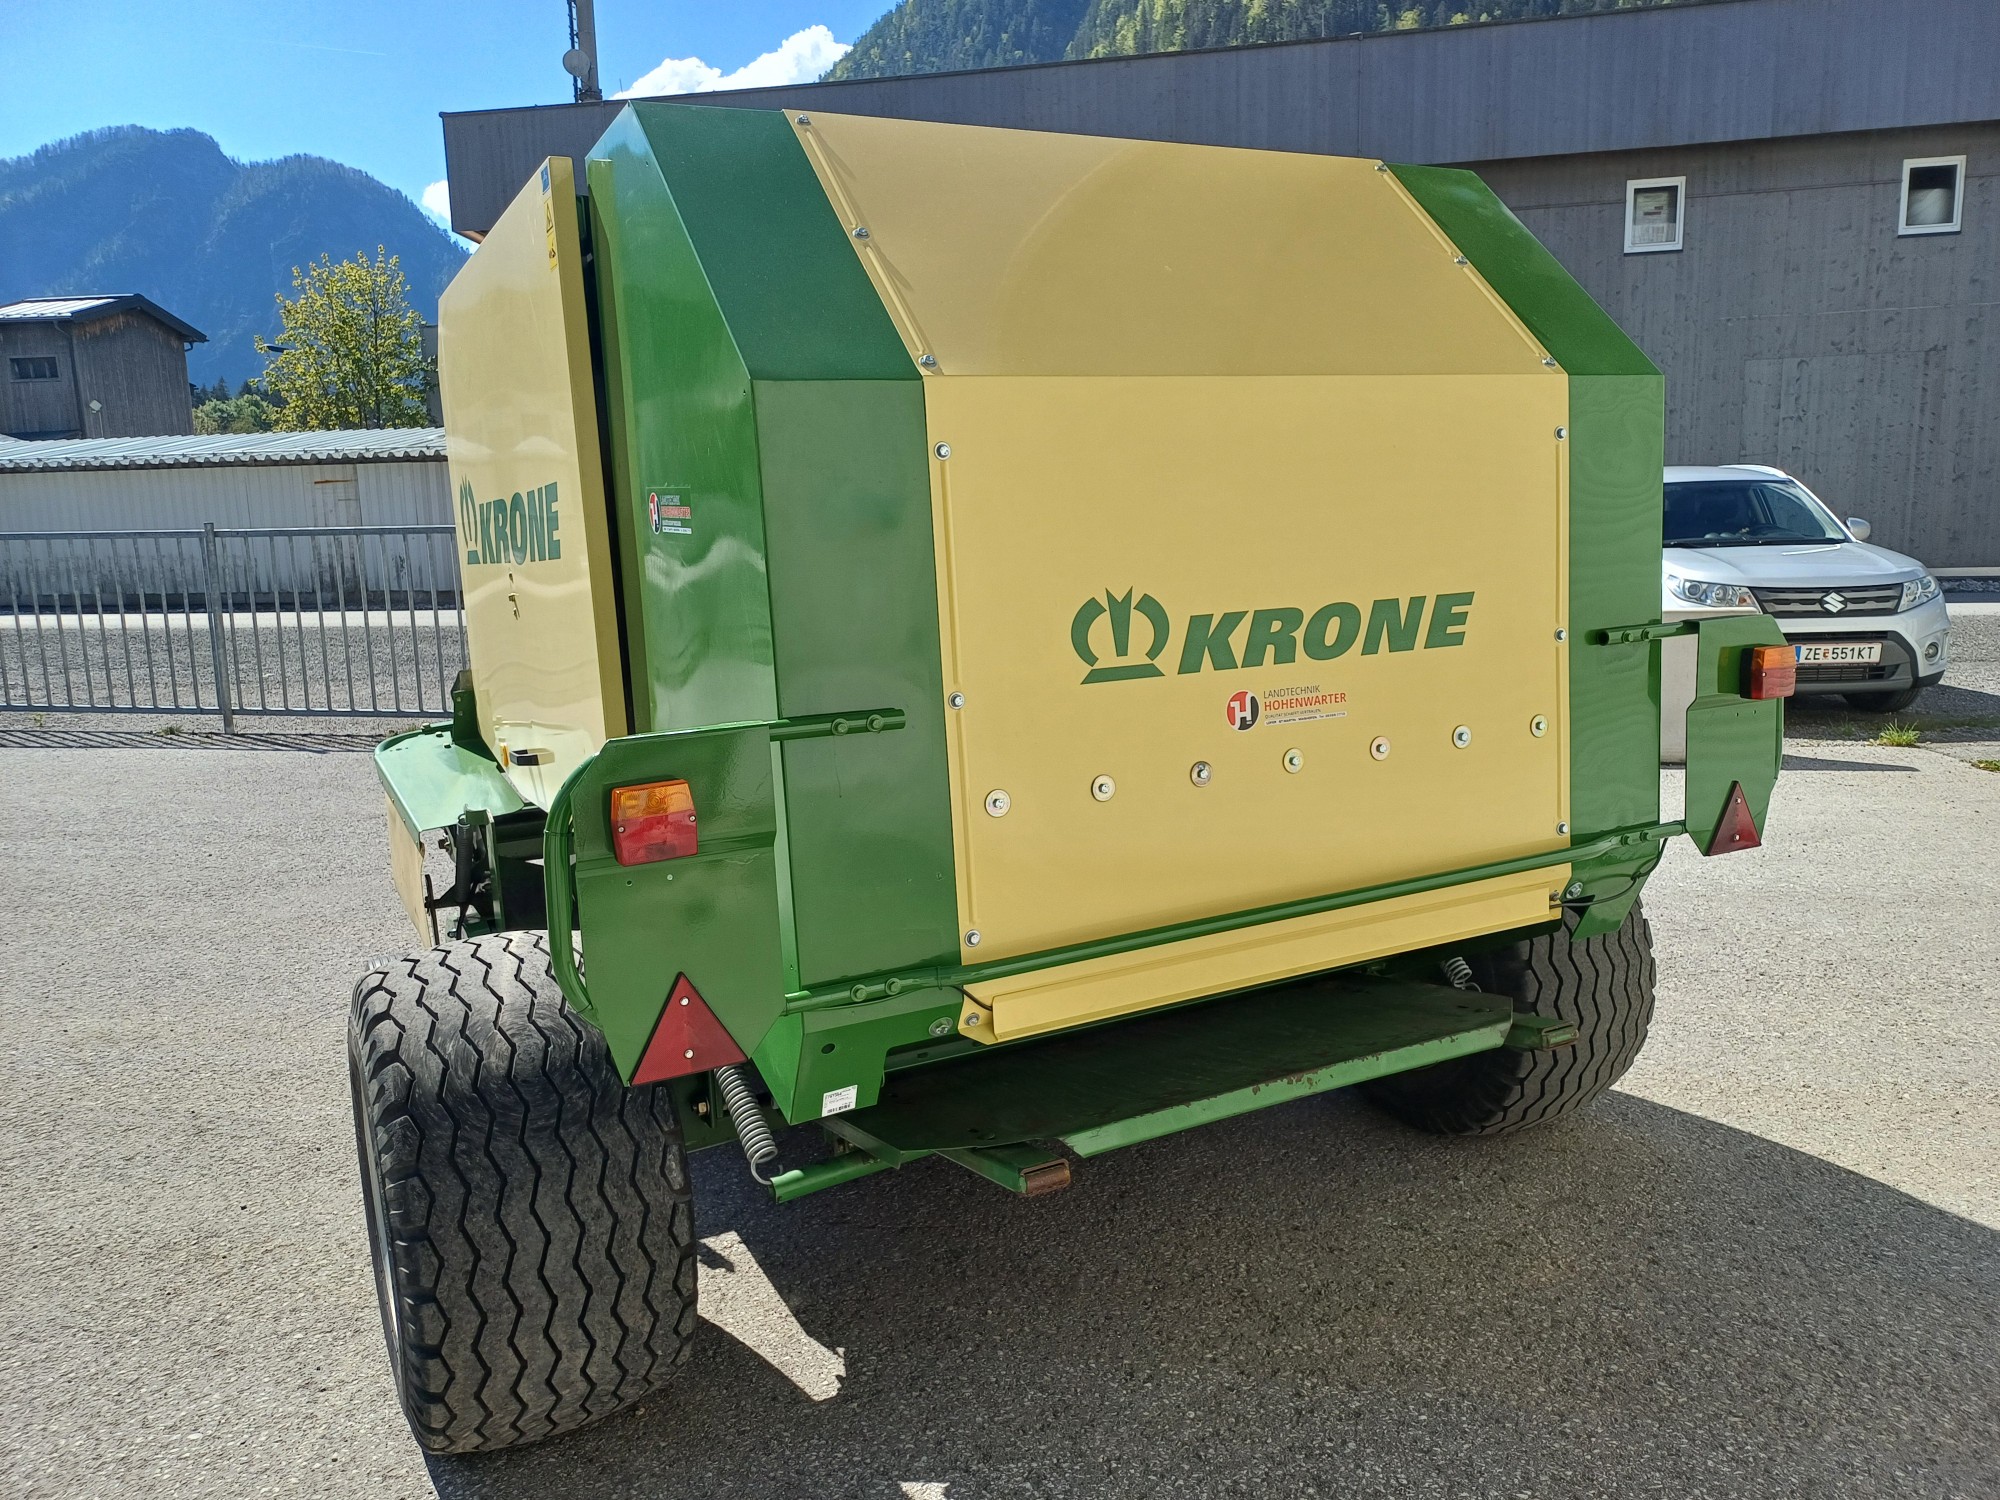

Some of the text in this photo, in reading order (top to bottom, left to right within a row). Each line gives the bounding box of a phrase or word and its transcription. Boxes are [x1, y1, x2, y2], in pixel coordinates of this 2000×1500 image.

[479, 481, 561, 566] KRONE
[1177, 591, 1475, 675] KRONE
[1804, 646, 1875, 660] ZE 551KT
[1263, 685, 1321, 699] LANDTECHNIK
[1264, 692, 1347, 712] HOHENWARTER
